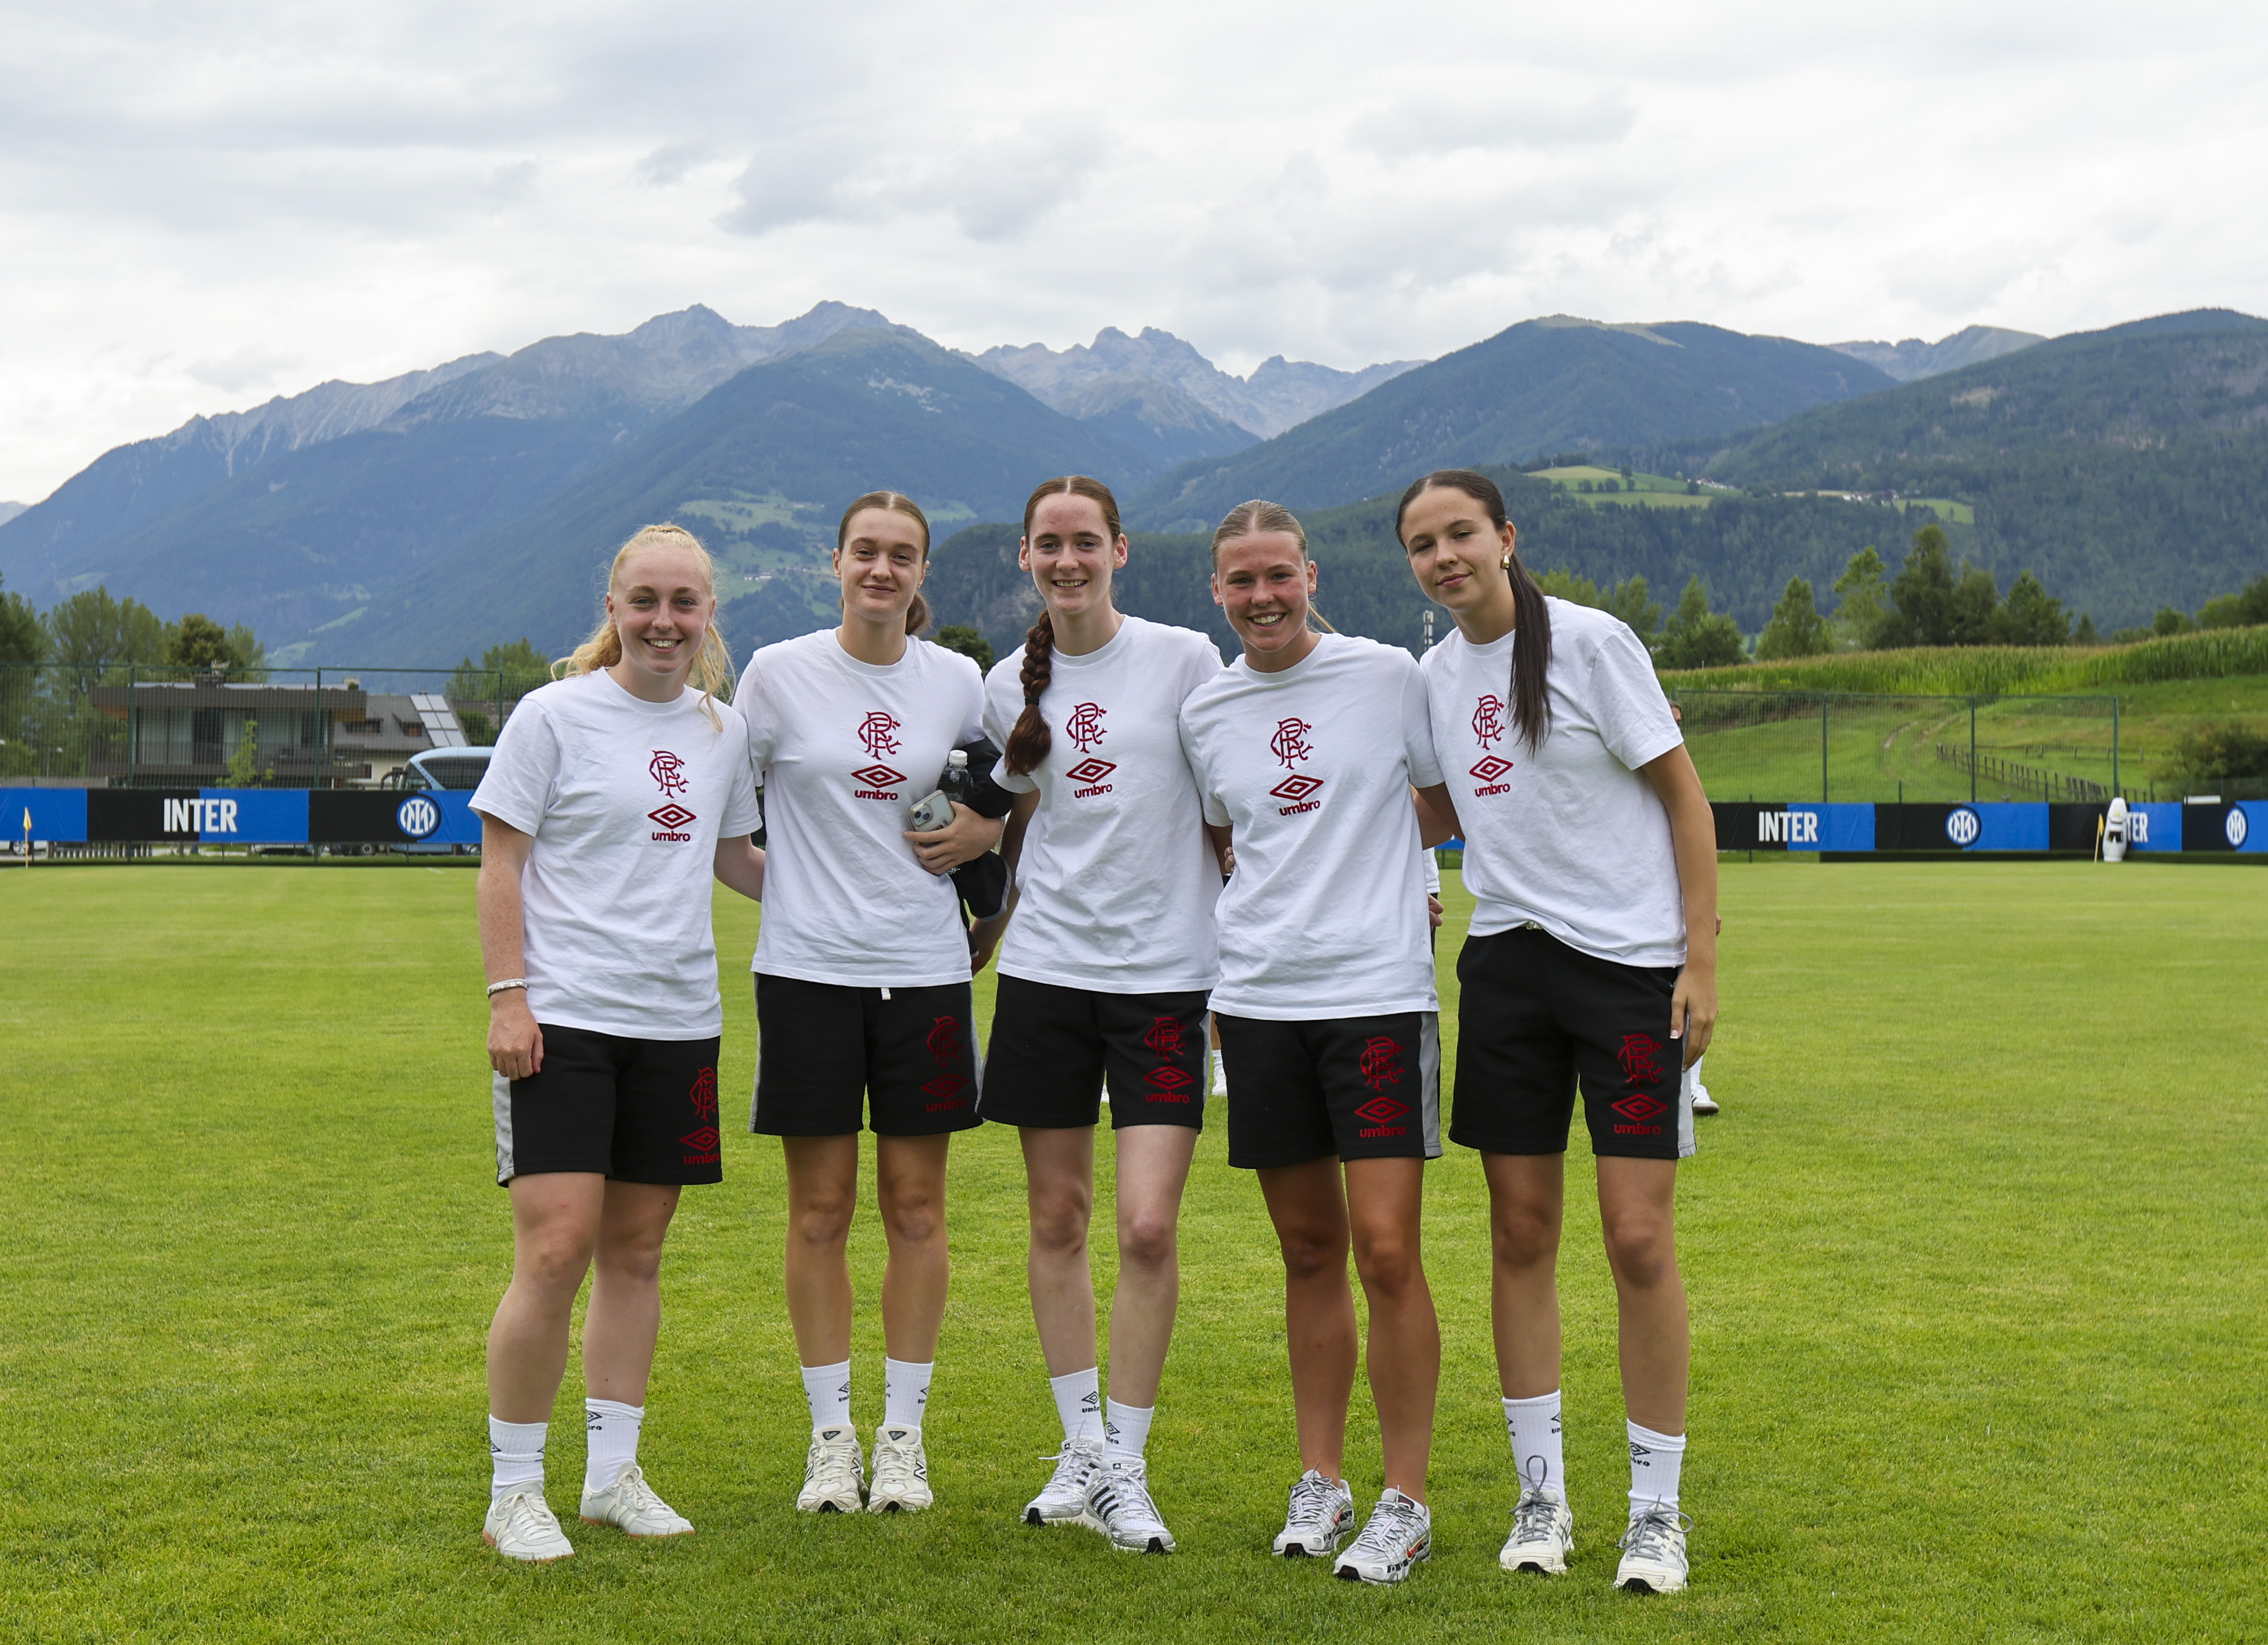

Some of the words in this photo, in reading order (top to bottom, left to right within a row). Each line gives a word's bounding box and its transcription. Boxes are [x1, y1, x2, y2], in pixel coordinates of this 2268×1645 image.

[854, 789, 898, 800] umbro
[1074, 783, 1112, 798] umbro
[1475, 783, 1510, 797] umbro
[1279, 800, 1320, 815] umbro
[163, 798, 238, 832] INTER
[1758, 811, 1817, 842] INTER
[2127, 811, 2149, 842] TER
[652, 831, 690, 841] umbro
[1146, 1091, 1190, 1103] umbro
[925, 1098, 967, 1112] umbro
[1359, 1125, 1407, 1138] umbro
[1614, 1122, 1661, 1135] umbro
